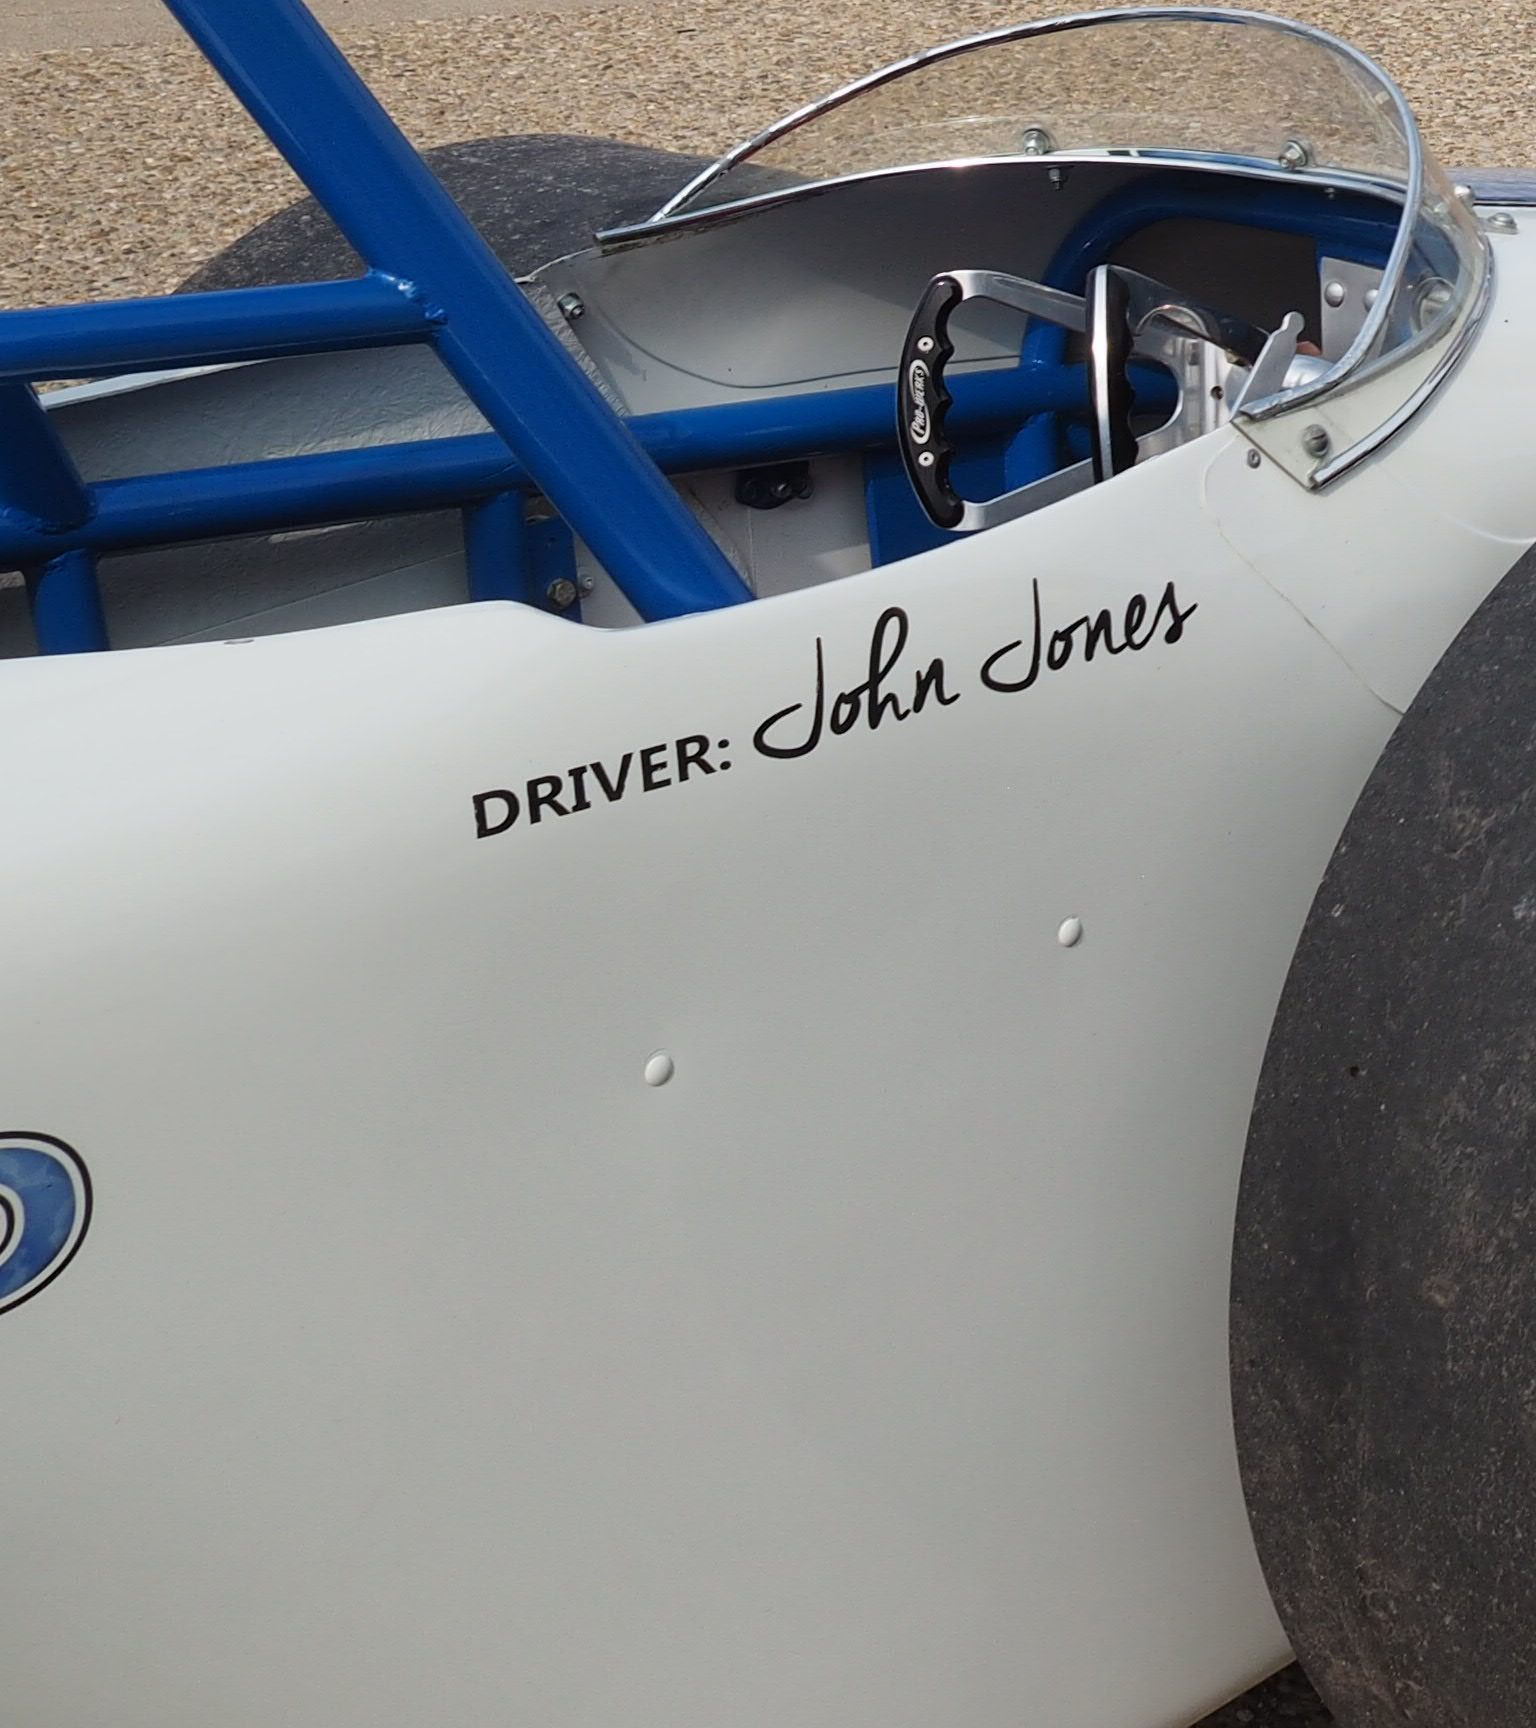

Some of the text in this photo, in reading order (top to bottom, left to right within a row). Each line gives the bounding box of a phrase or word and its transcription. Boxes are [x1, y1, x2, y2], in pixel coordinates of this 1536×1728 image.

[470, 576, 1199, 840] DRIVER: John Jones
